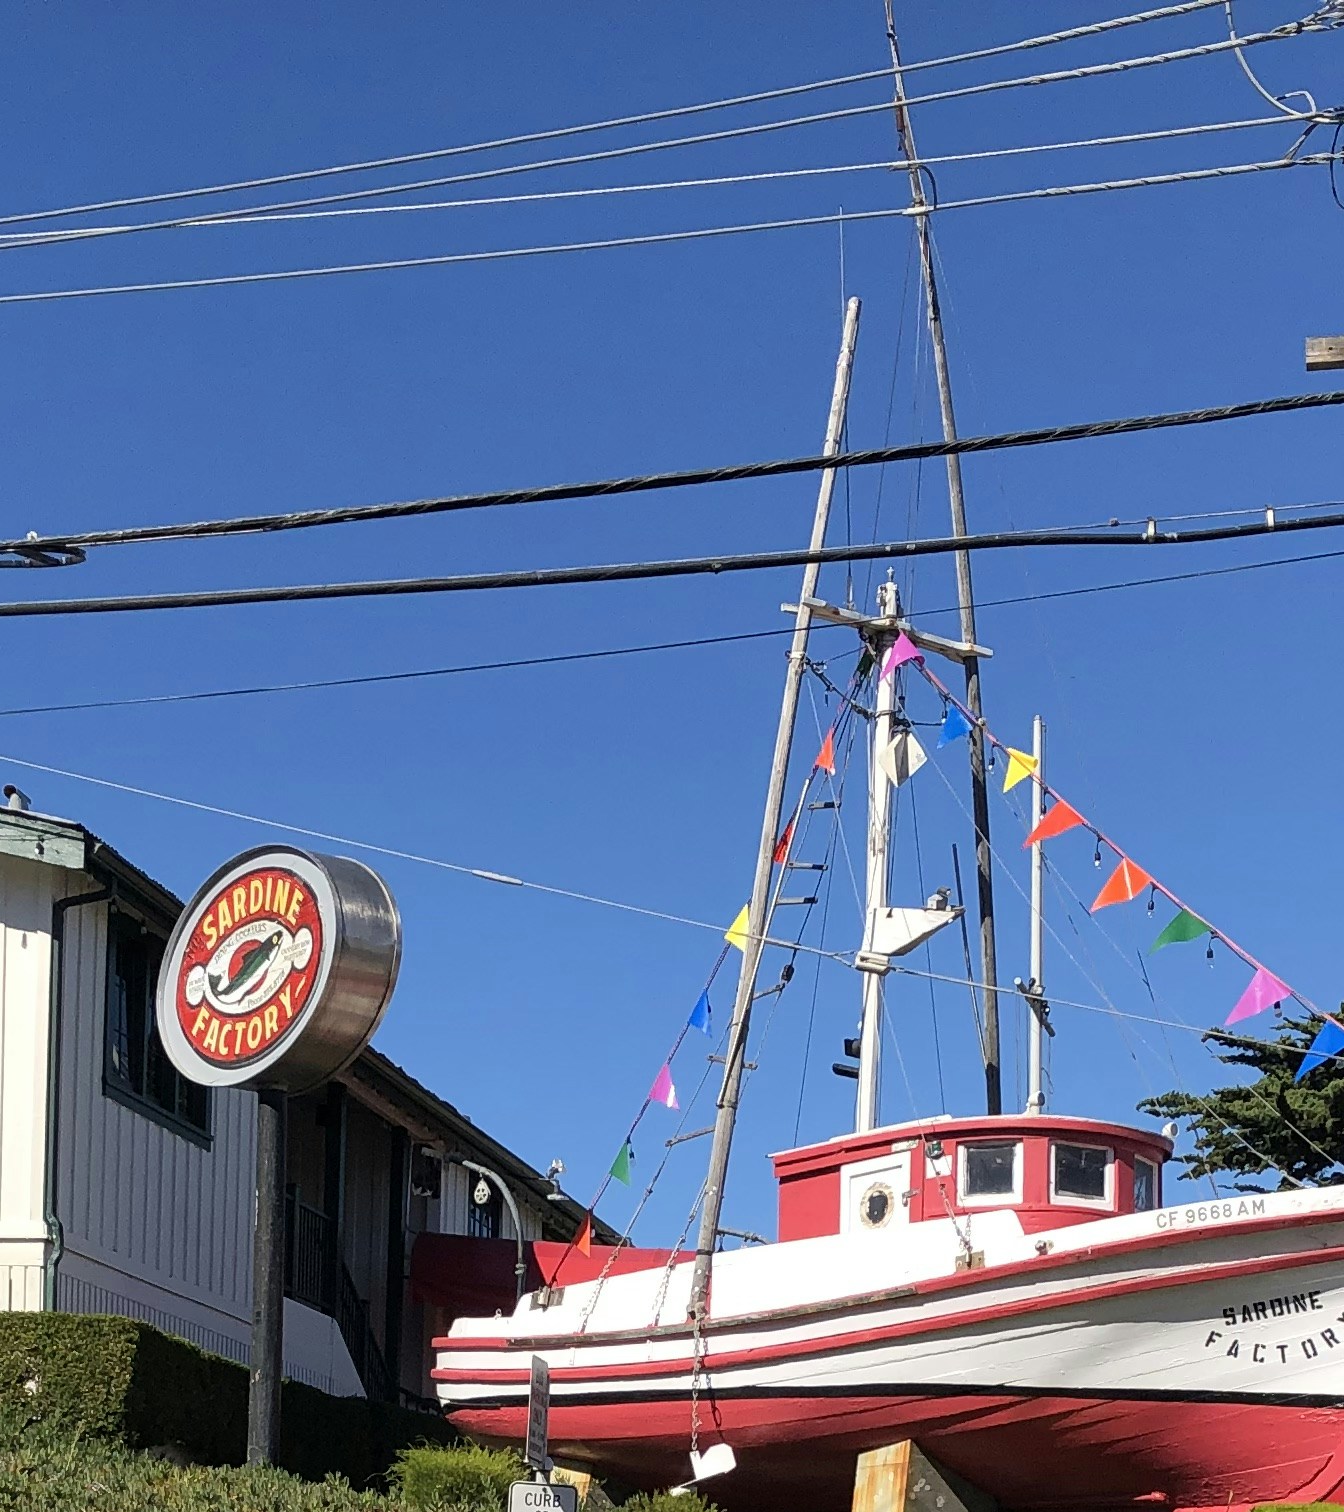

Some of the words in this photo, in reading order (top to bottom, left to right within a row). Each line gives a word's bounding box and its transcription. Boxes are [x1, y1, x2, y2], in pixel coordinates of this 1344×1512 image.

[202, 877, 305, 951] SARDINE
[191, 985, 297, 1056] FACTORY
[1156, 1211, 1179, 1228] CF
[1185, 1203, 1233, 1223] 9668
[1237, 1198, 1266, 1216] AM
[1222, 1290, 1324, 1326] SARDINE
[524, 1492, 562, 1508] CURB
